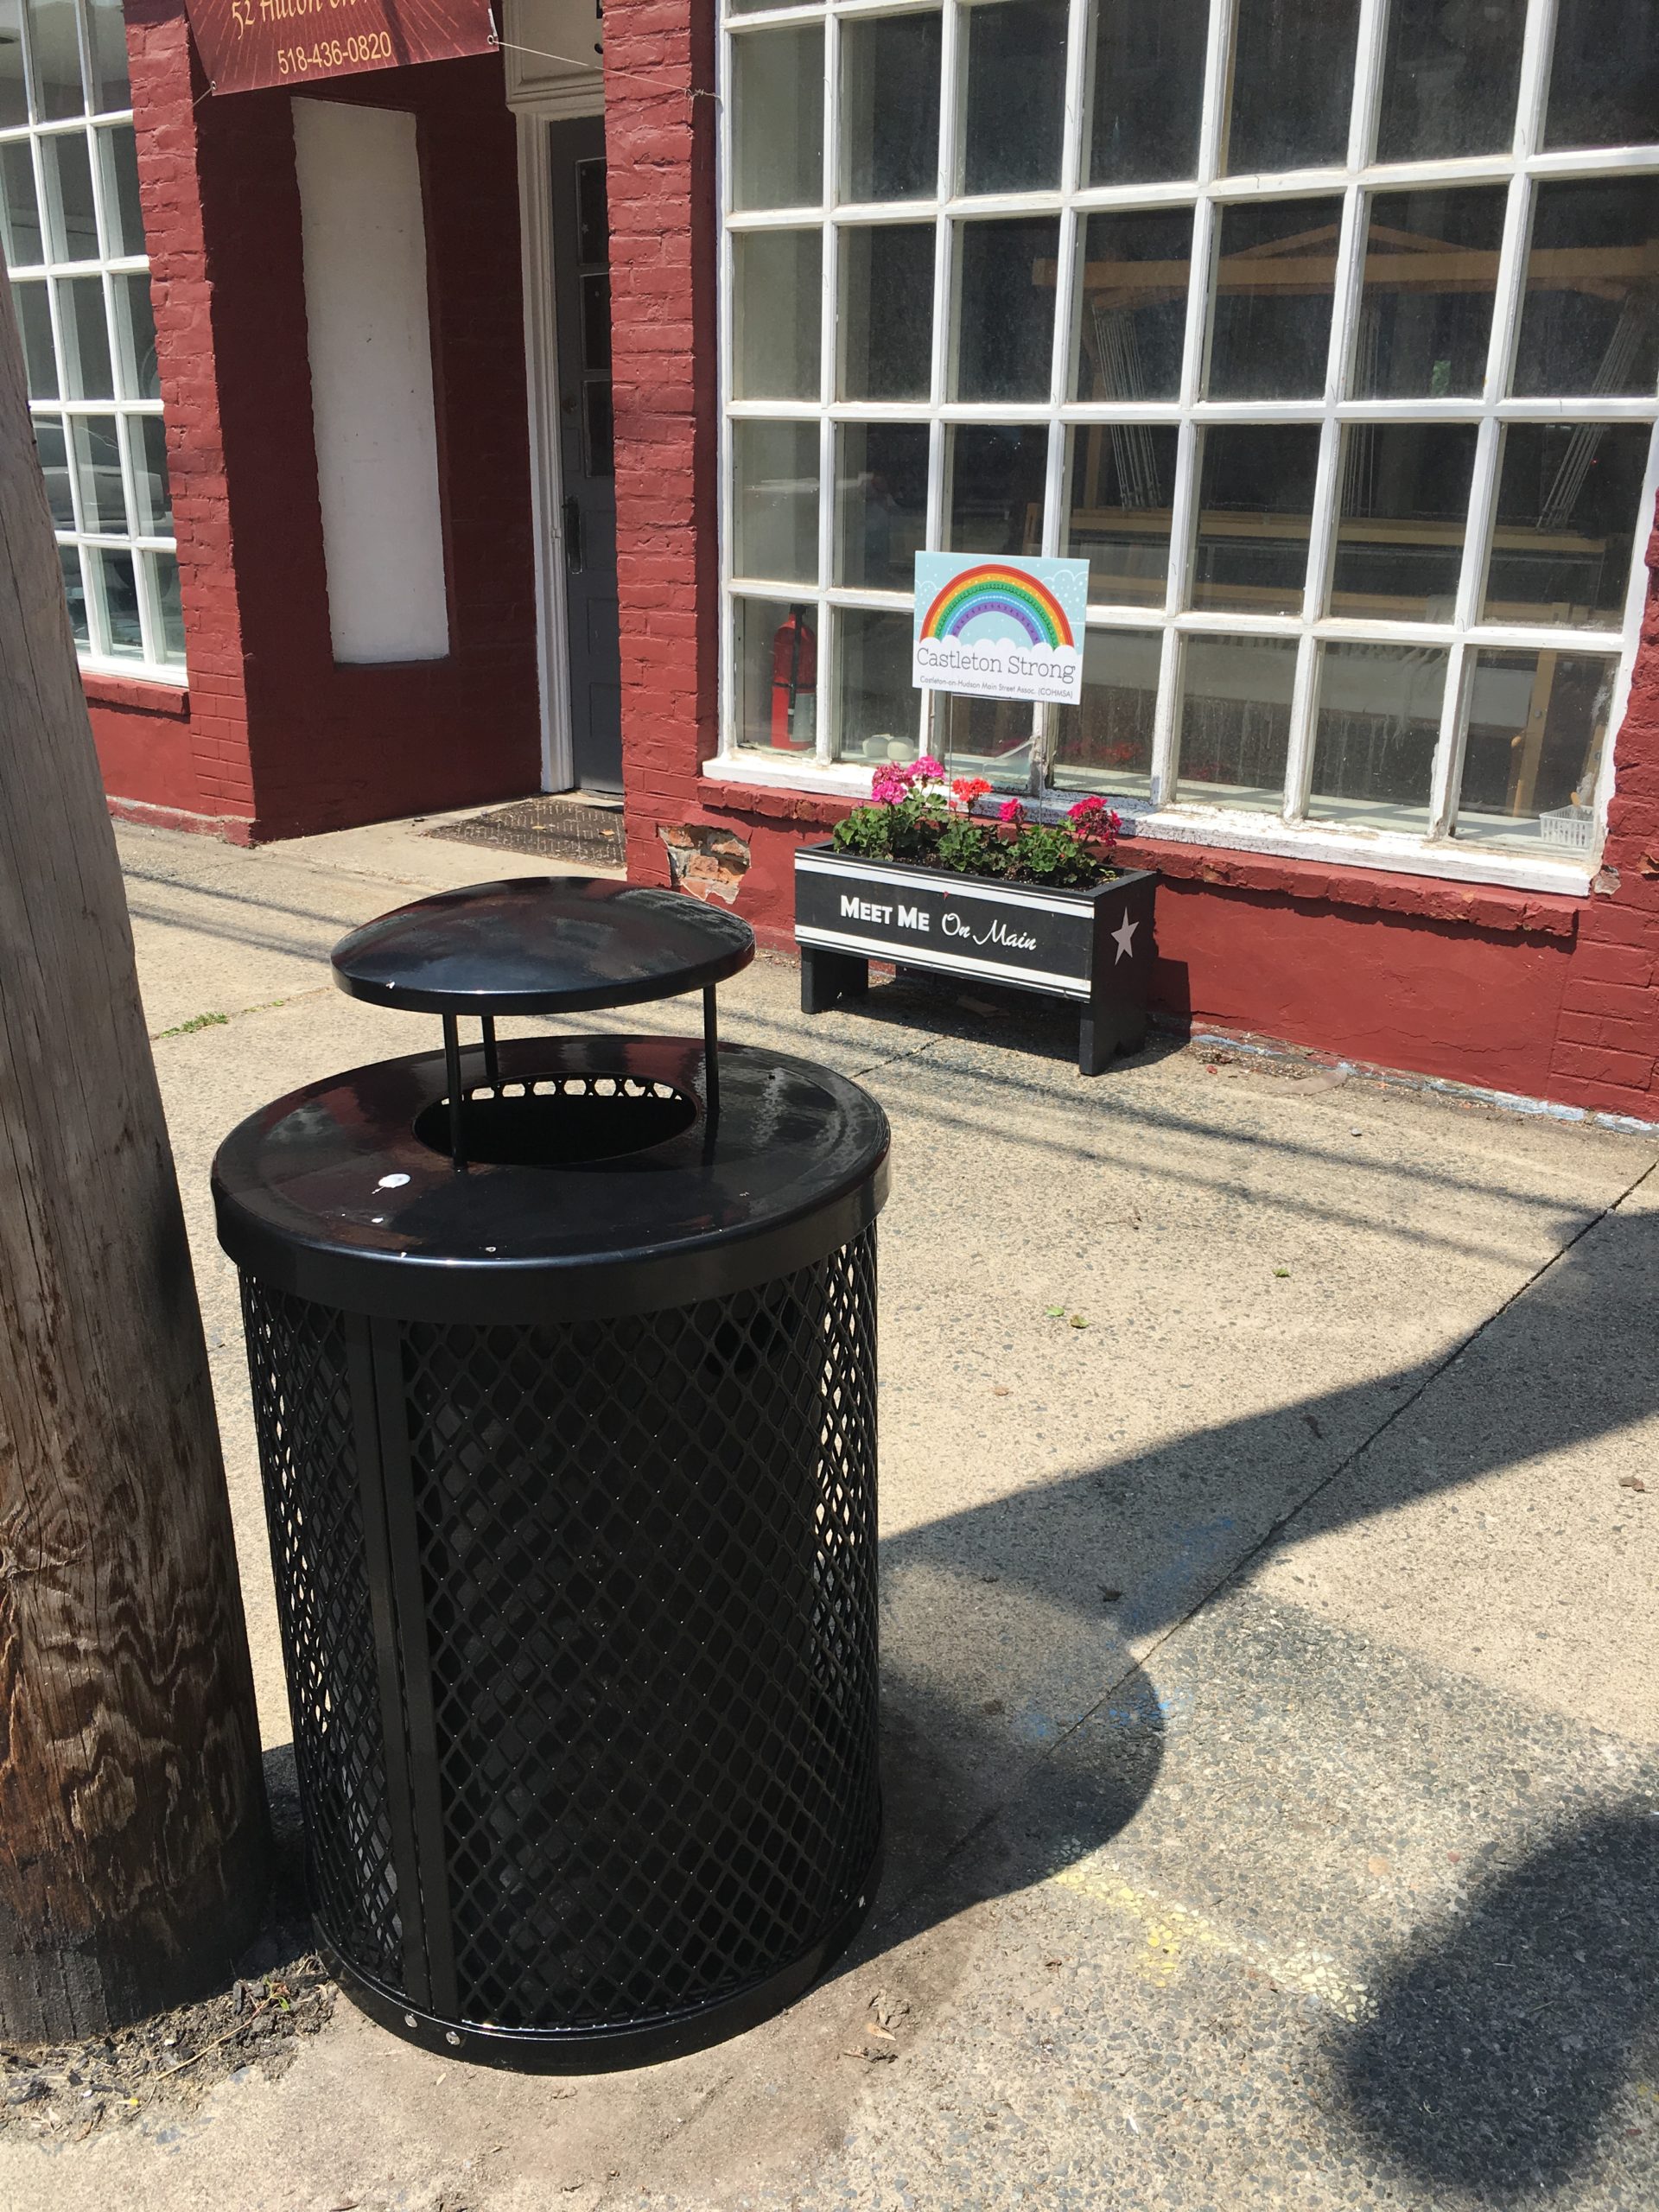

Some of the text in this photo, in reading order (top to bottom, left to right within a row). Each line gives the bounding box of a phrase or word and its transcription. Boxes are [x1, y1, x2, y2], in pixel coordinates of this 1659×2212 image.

[232, 1, 256, 40] 52
[276, 30, 391, 75] 518-436-0820
[917, 647, 1077, 684] Castleton Strong
[982, 682, 997, 690] Main
[998, 683, 1016, 693] Street
[941, 912, 971, 939] On
[972, 919, 1038, 951] Main
